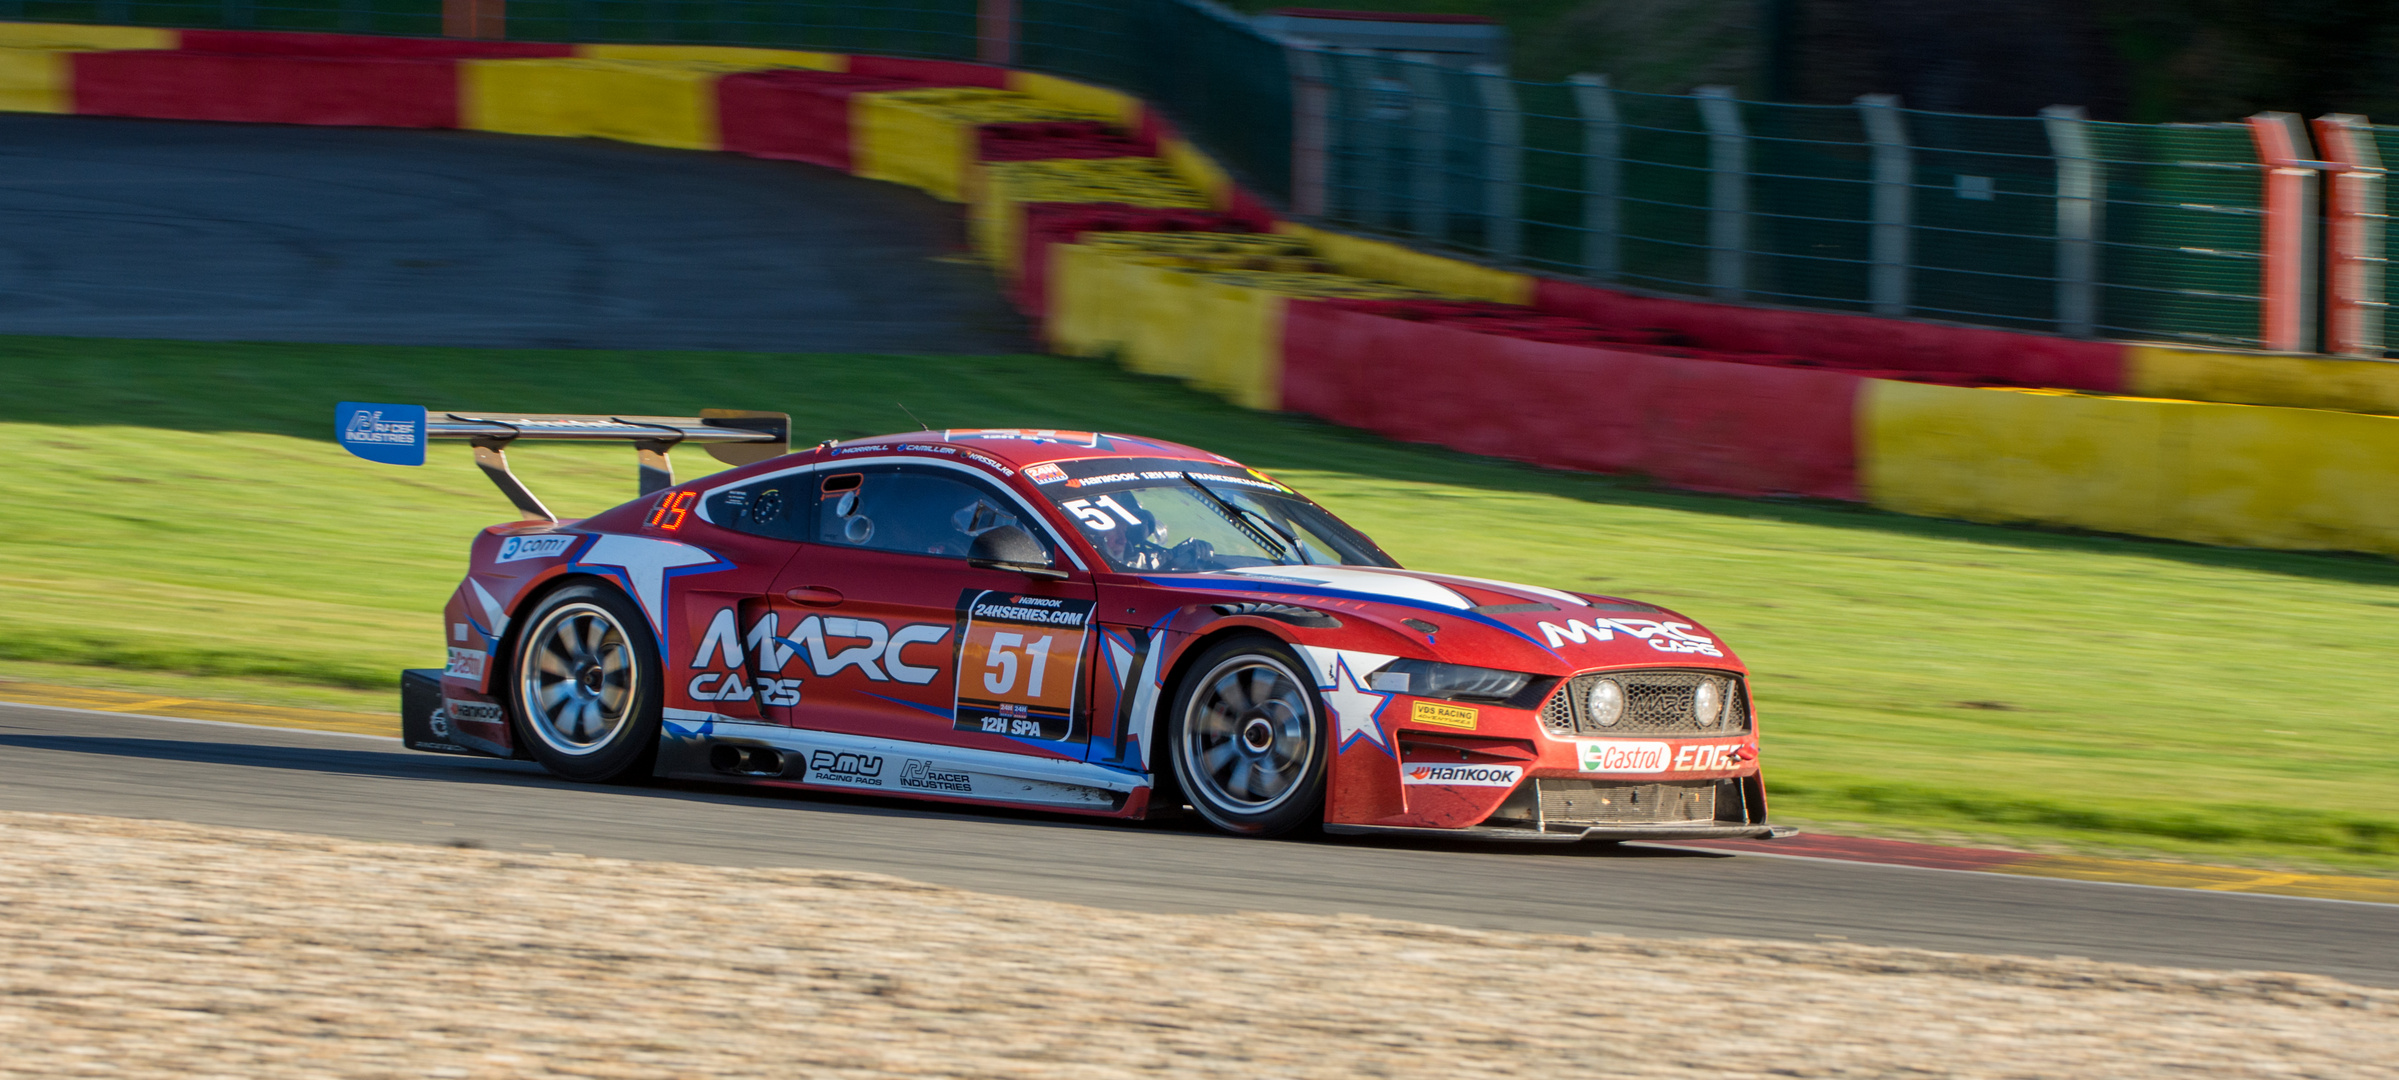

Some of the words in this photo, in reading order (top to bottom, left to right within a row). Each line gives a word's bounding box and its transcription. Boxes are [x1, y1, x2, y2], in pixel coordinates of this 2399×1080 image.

[345, 431, 415, 443] INDUSTRIES
[905, 444, 957, 455] CAMILLERI
[968, 452, 1015, 477] KASSULKE
[1079, 472, 1140, 487] Hankook
[652, 491, 697, 531] 15
[1062, 494, 1142, 531] 51
[1018, 596, 1063, 608] Hankook
[974, 604, 1083, 626] 24HSERIES.COM
[1537, 617, 1714, 649] MARC
[691, 606, 952, 685] MARC
[1648, 638, 1724, 658] CARS
[984, 631, 1053, 698] 51
[687, 672, 803, 707] CARS
[1417, 705, 1436, 715] VDS
[1437, 707, 1472, 720] RACING
[981, 716, 1008, 734] 12H
[1011, 719, 1041, 737] SPA
[1603, 746, 1662, 770] Castrol
[815, 772, 853, 783] RACING
[855, 776, 882, 786] PADS
[928, 773, 970, 783] RACER
[1429, 767, 1516, 783] Hankook
[900, 779, 972, 792] INDUSTRIES
